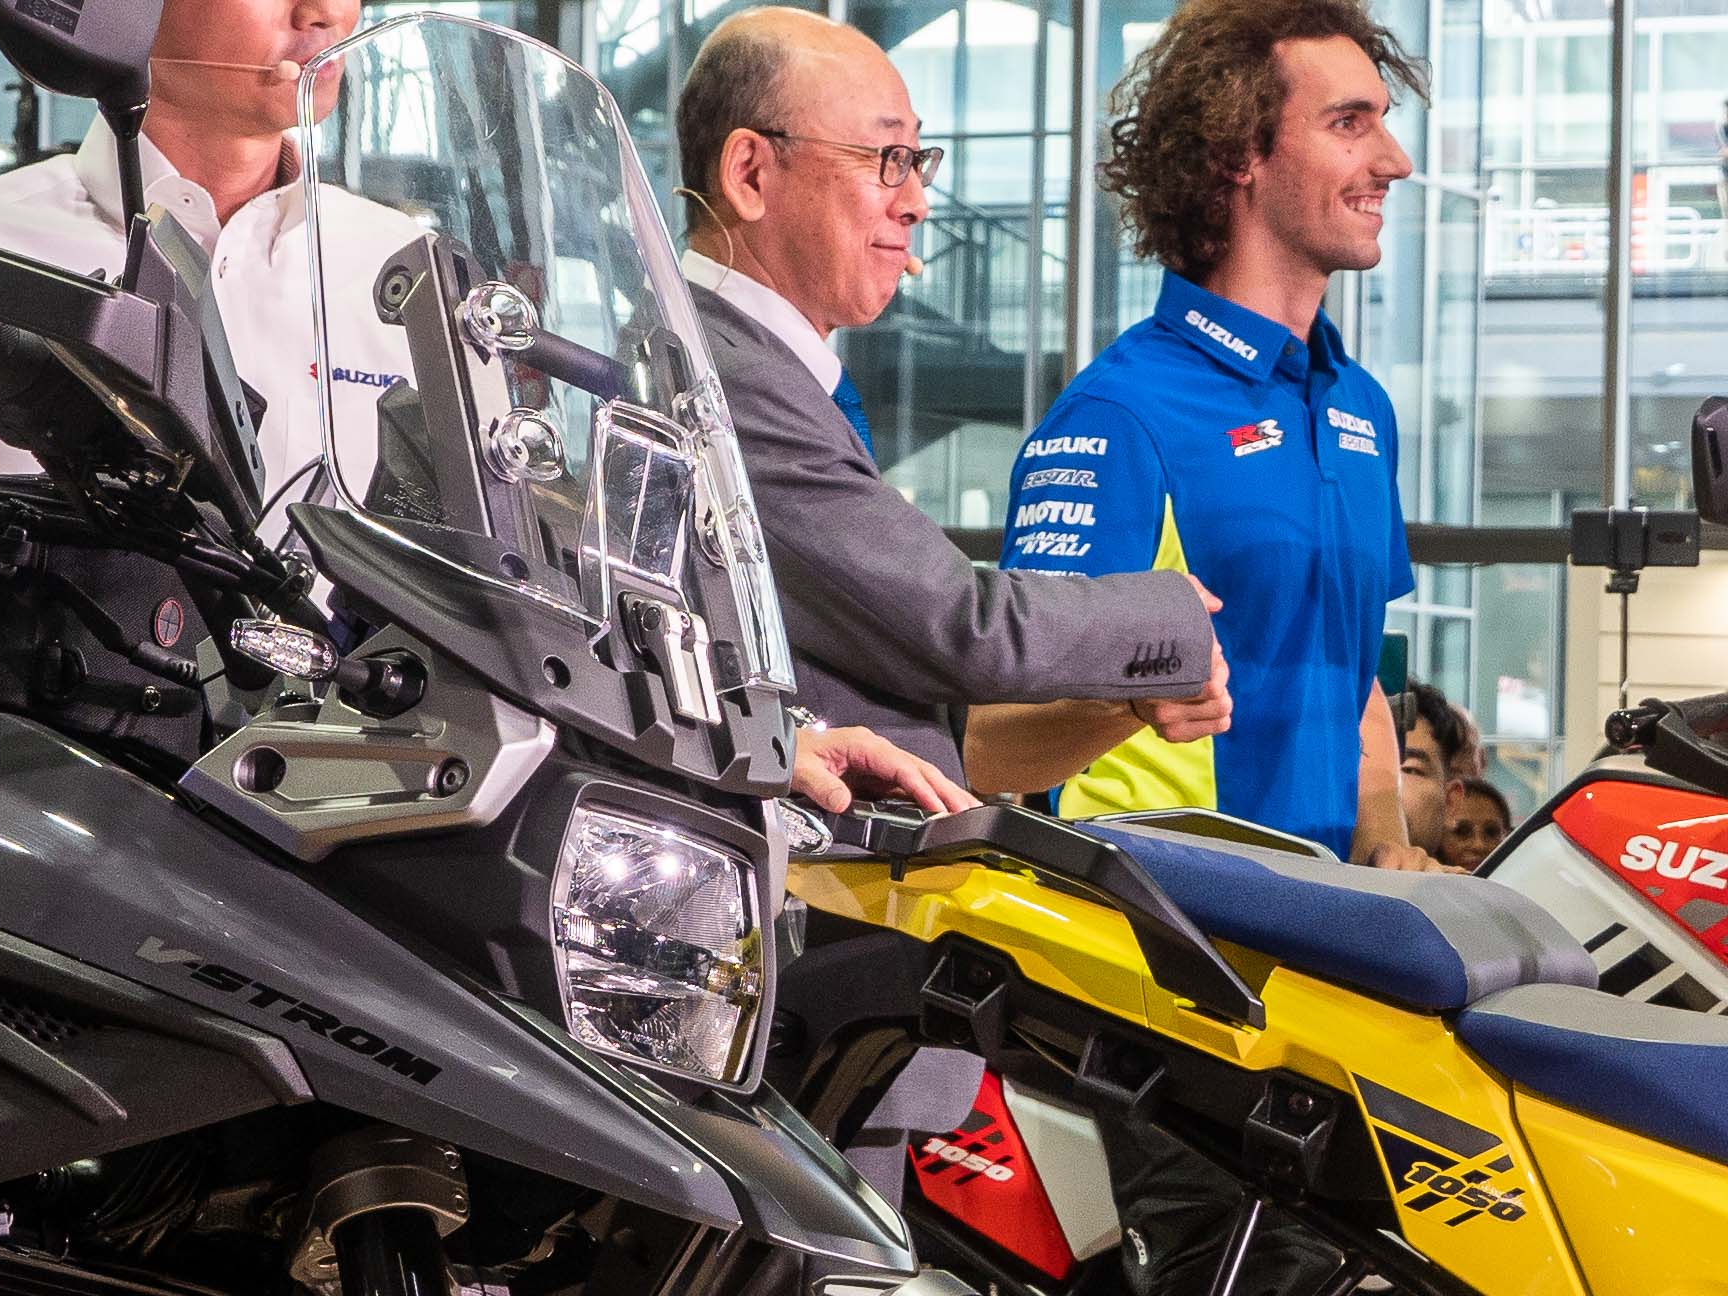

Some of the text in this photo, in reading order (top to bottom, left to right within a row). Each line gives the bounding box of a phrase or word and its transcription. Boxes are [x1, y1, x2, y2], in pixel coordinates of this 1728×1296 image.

[1186, 308, 1259, 362] SUZUKI
[331, 367, 404, 389] SUZUK
[1326, 407, 1377, 438] SUZUKI
[1023, 436, 1109, 459] SUZUKI
[1014, 500, 1097, 529] MOTUL
[135, 936, 444, 1088] V-STROM
[922, 1136, 1015, 1182] 1050
[1403, 1161, 1528, 1223] 1050
